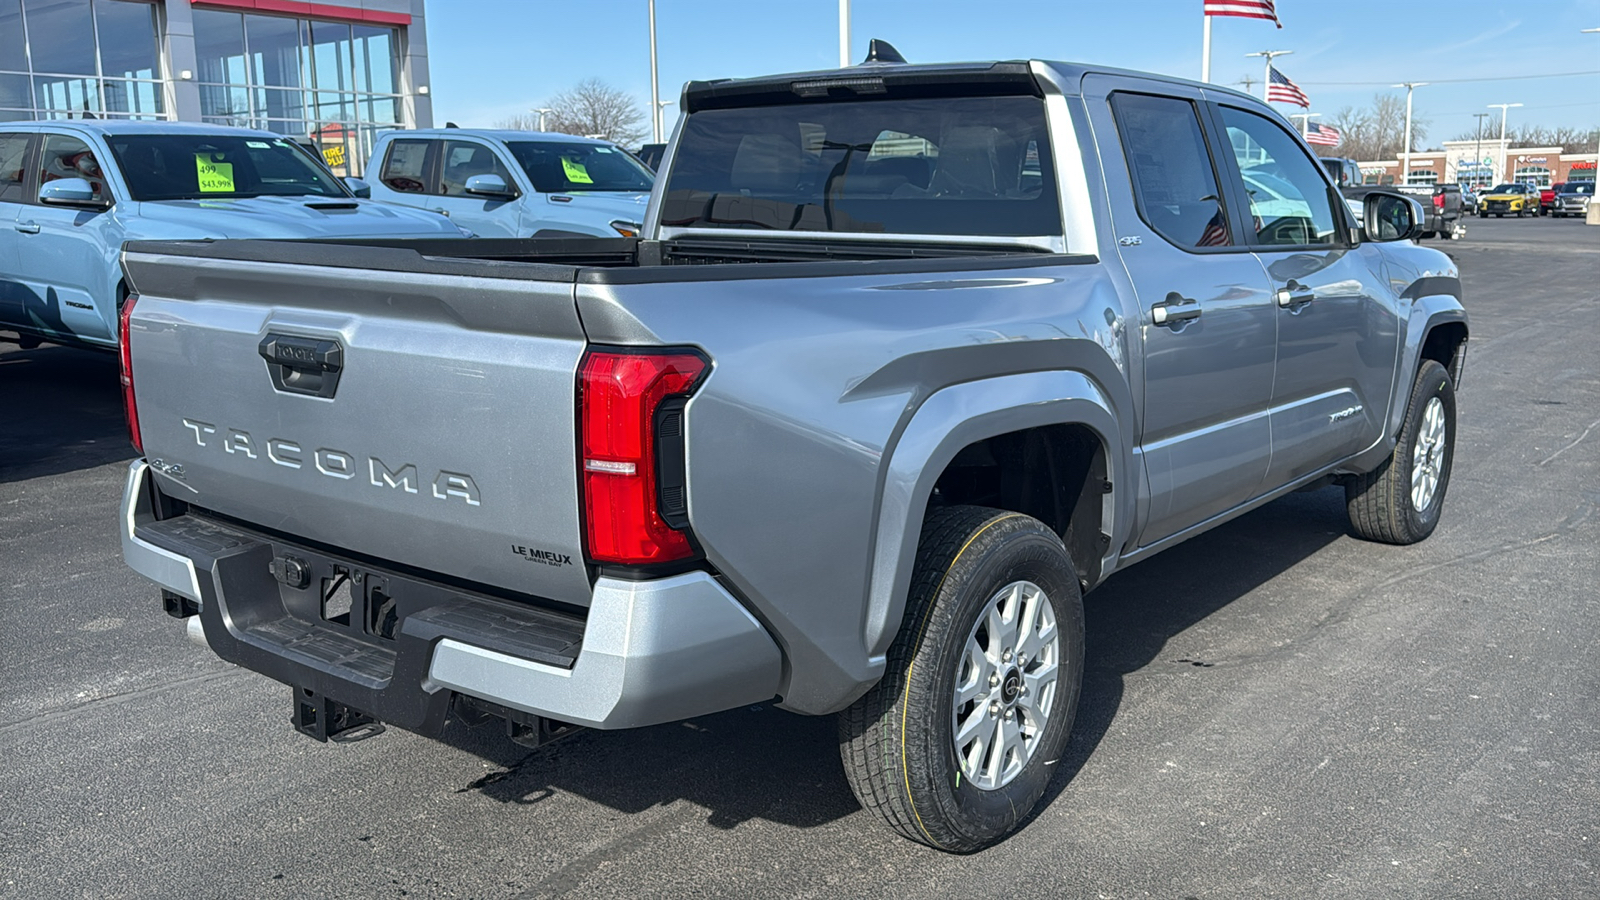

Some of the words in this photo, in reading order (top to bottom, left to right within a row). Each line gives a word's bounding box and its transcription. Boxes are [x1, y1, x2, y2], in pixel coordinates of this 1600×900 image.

[326, 155, 346, 166] PLU
[200, 165, 217, 174] 499
[202, 180, 232, 189] $43,998
[277, 345, 315, 361] TOYOTA
[183, 417, 481, 506] TACOMA
[511, 544, 527, 556] LE
[529, 548, 573, 565] MIEUX
[524, 556, 547, 565] GREEN
